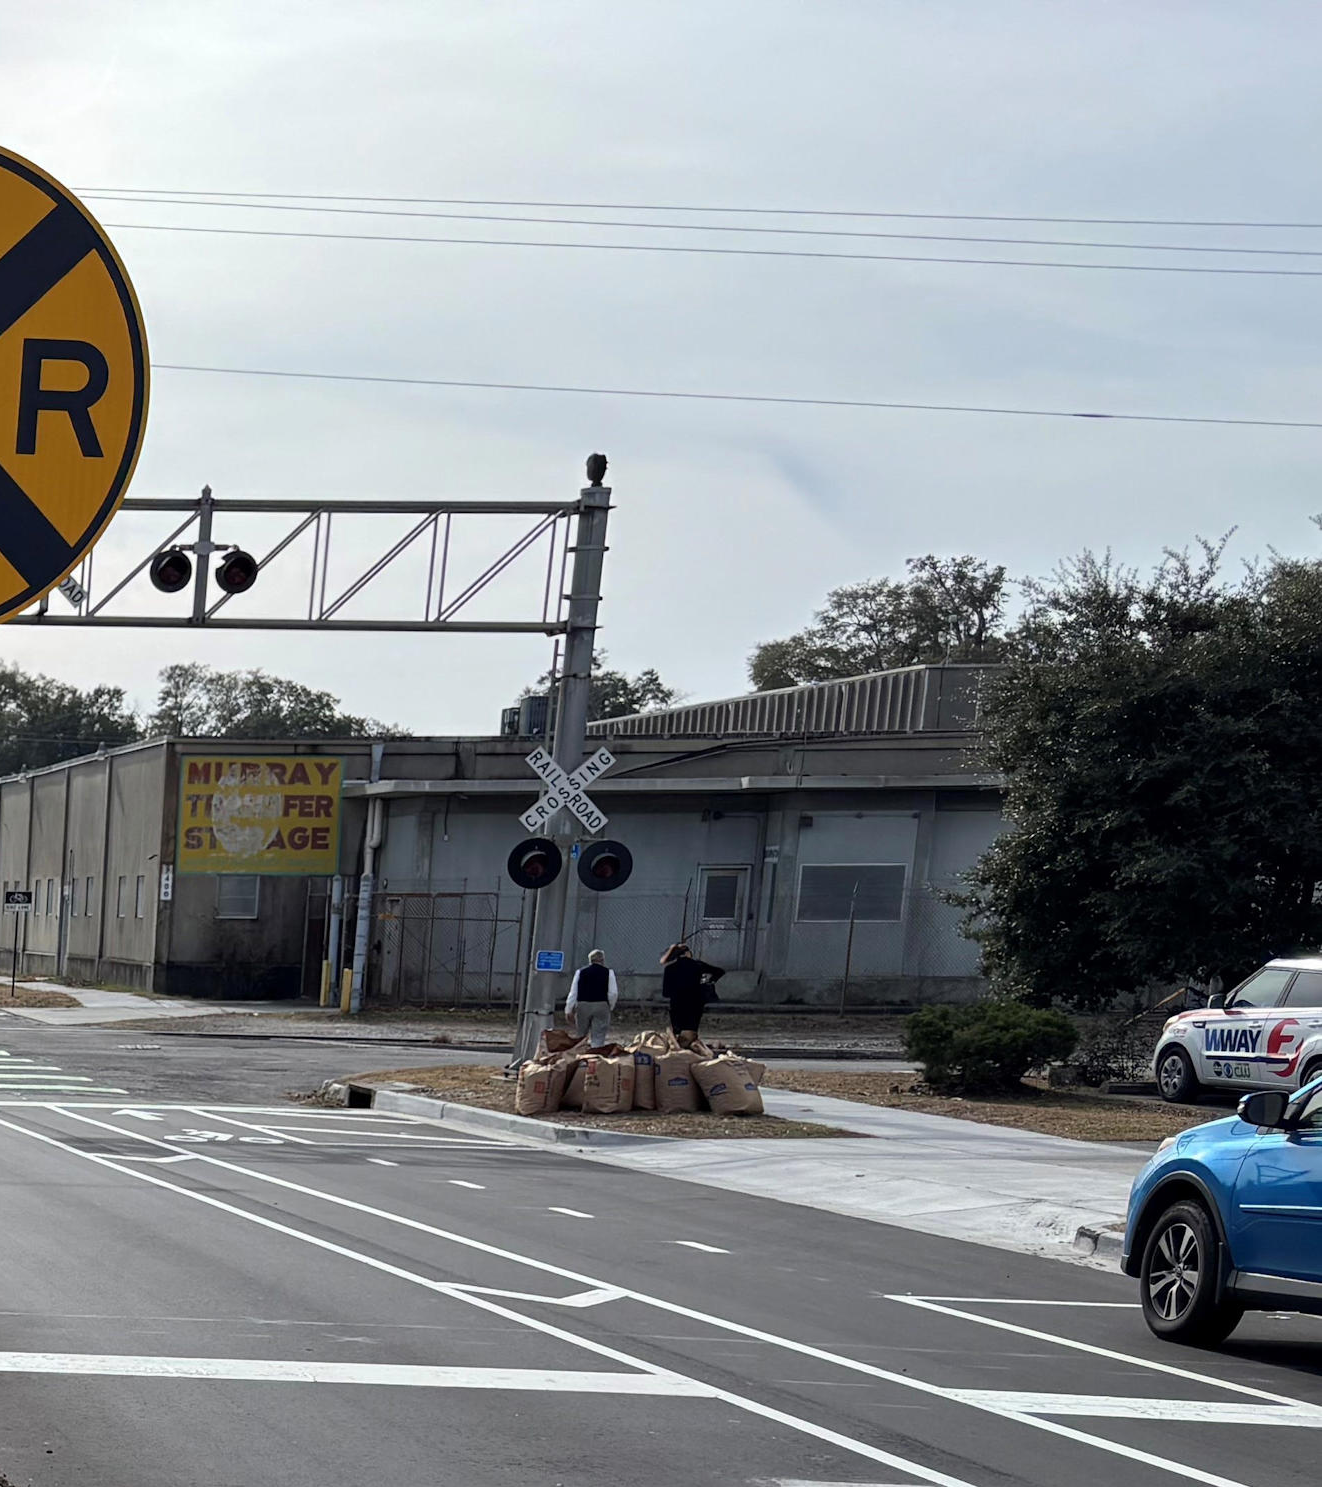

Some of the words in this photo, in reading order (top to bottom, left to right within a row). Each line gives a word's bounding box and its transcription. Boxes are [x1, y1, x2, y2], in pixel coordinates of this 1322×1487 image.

[15, 338, 109, 458] R
[525, 753, 610, 827] CROSSING
[1205, 1028, 1261, 1053] WWAY
